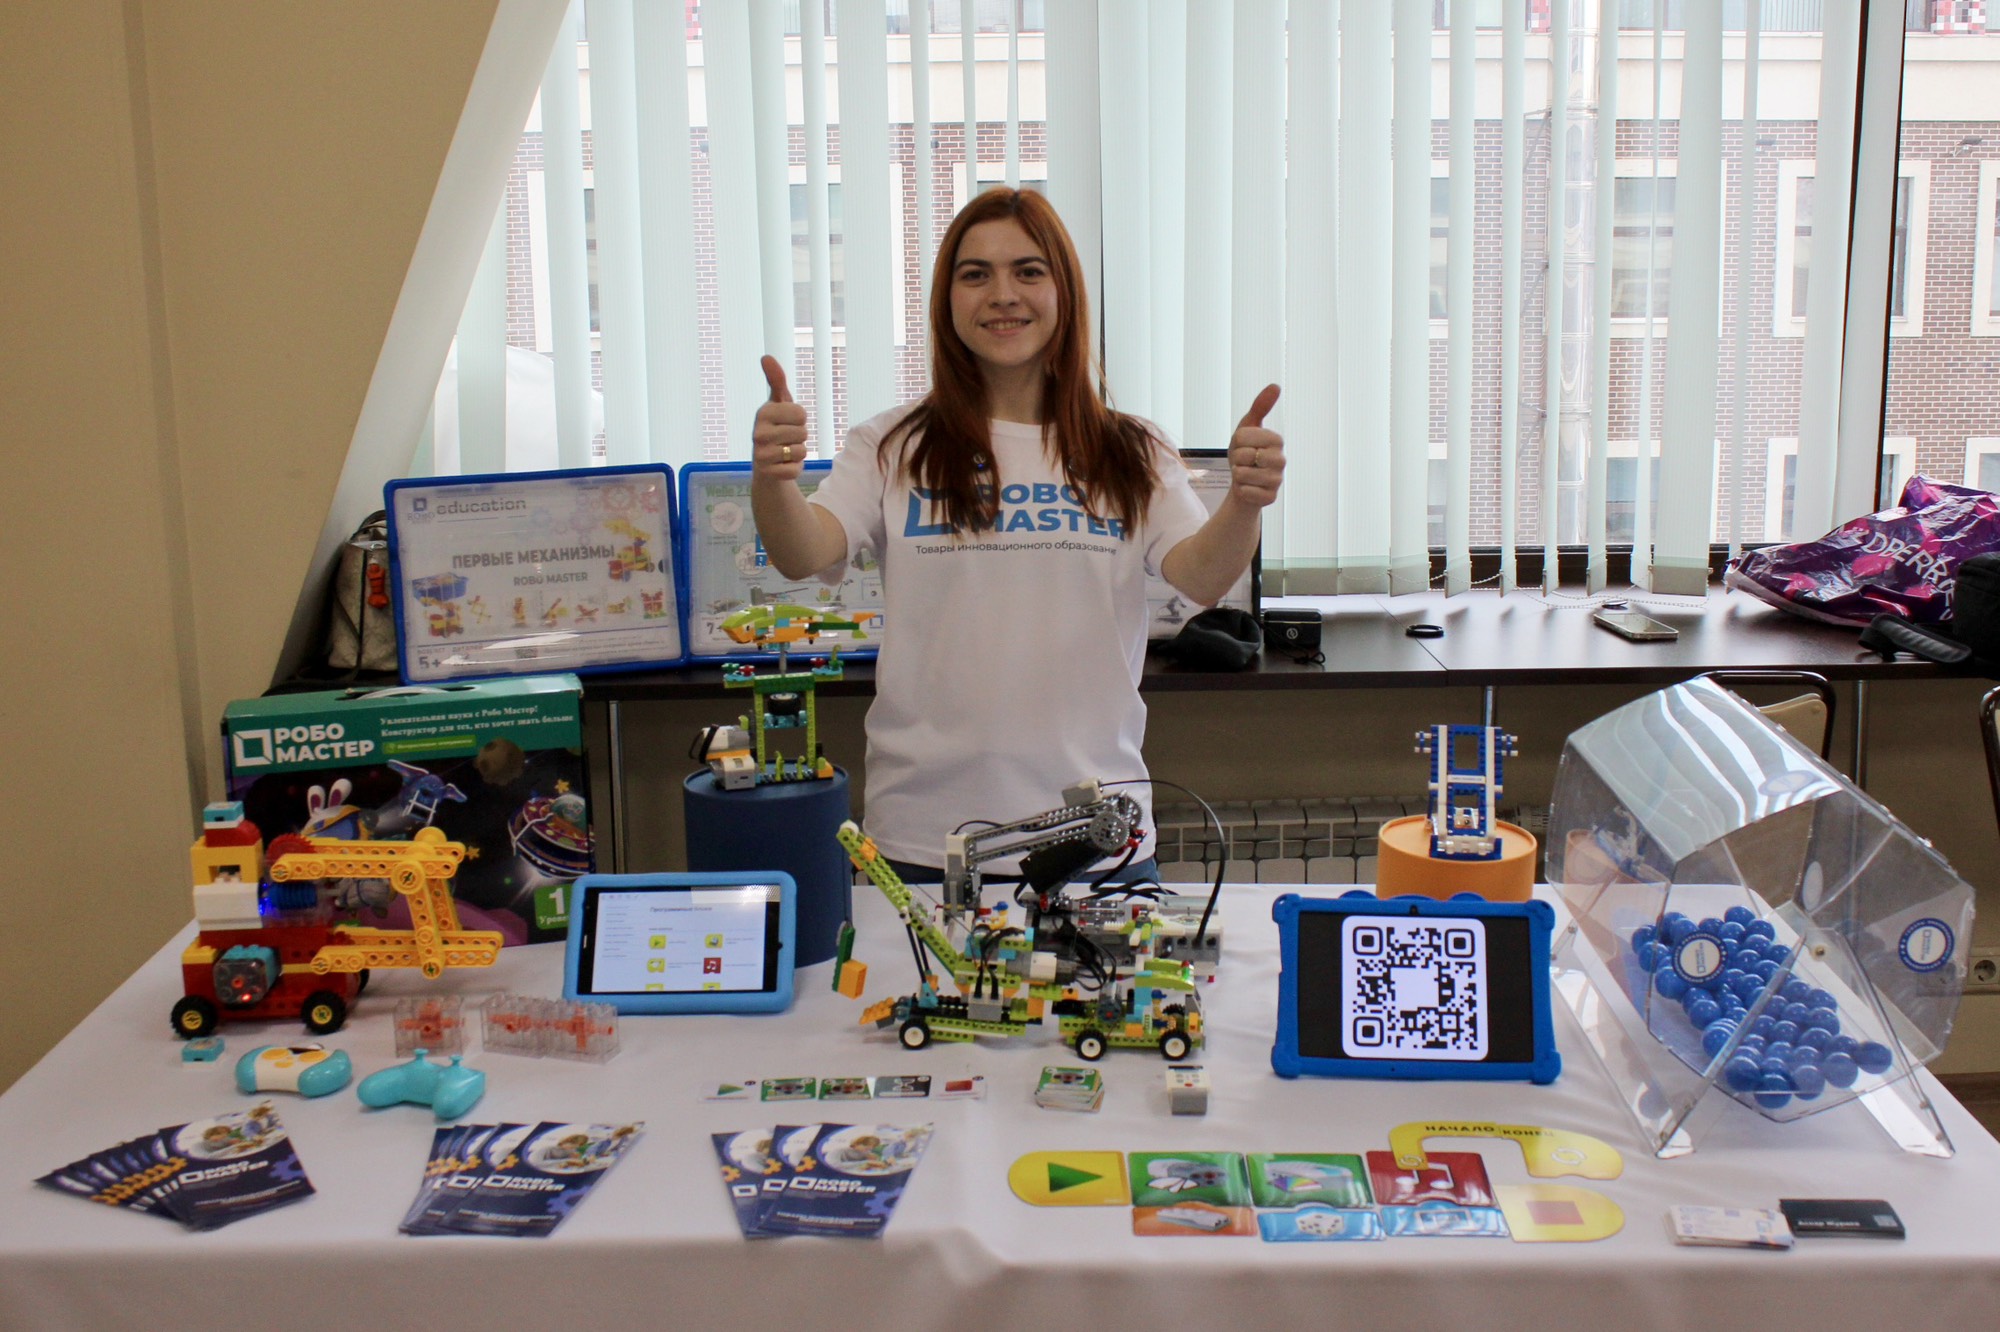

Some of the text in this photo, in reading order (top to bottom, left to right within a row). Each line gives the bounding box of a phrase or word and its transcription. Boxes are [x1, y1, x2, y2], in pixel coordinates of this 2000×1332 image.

[436, 497, 527, 515] education
[916, 544, 955, 555] Товары
[957, 540, 1053, 554] инновационного
[452, 544, 615, 570] ПЕРВЫЕ МЕХАНИЗМЫ
[513, 571, 588, 587] ROBO MASTER
[481, 708, 502, 718] Робо
[274, 723, 345, 744] РОБО
[381, 725, 438, 737] Конструктор
[474, 720, 490, 729] кто
[275, 740, 375, 763] МАСТЕР
[549, 887, 565, 915] 1
[1503, 1129, 1554, 1137] КОНЕЦ
[814, 1185, 877, 1193] MASTER
